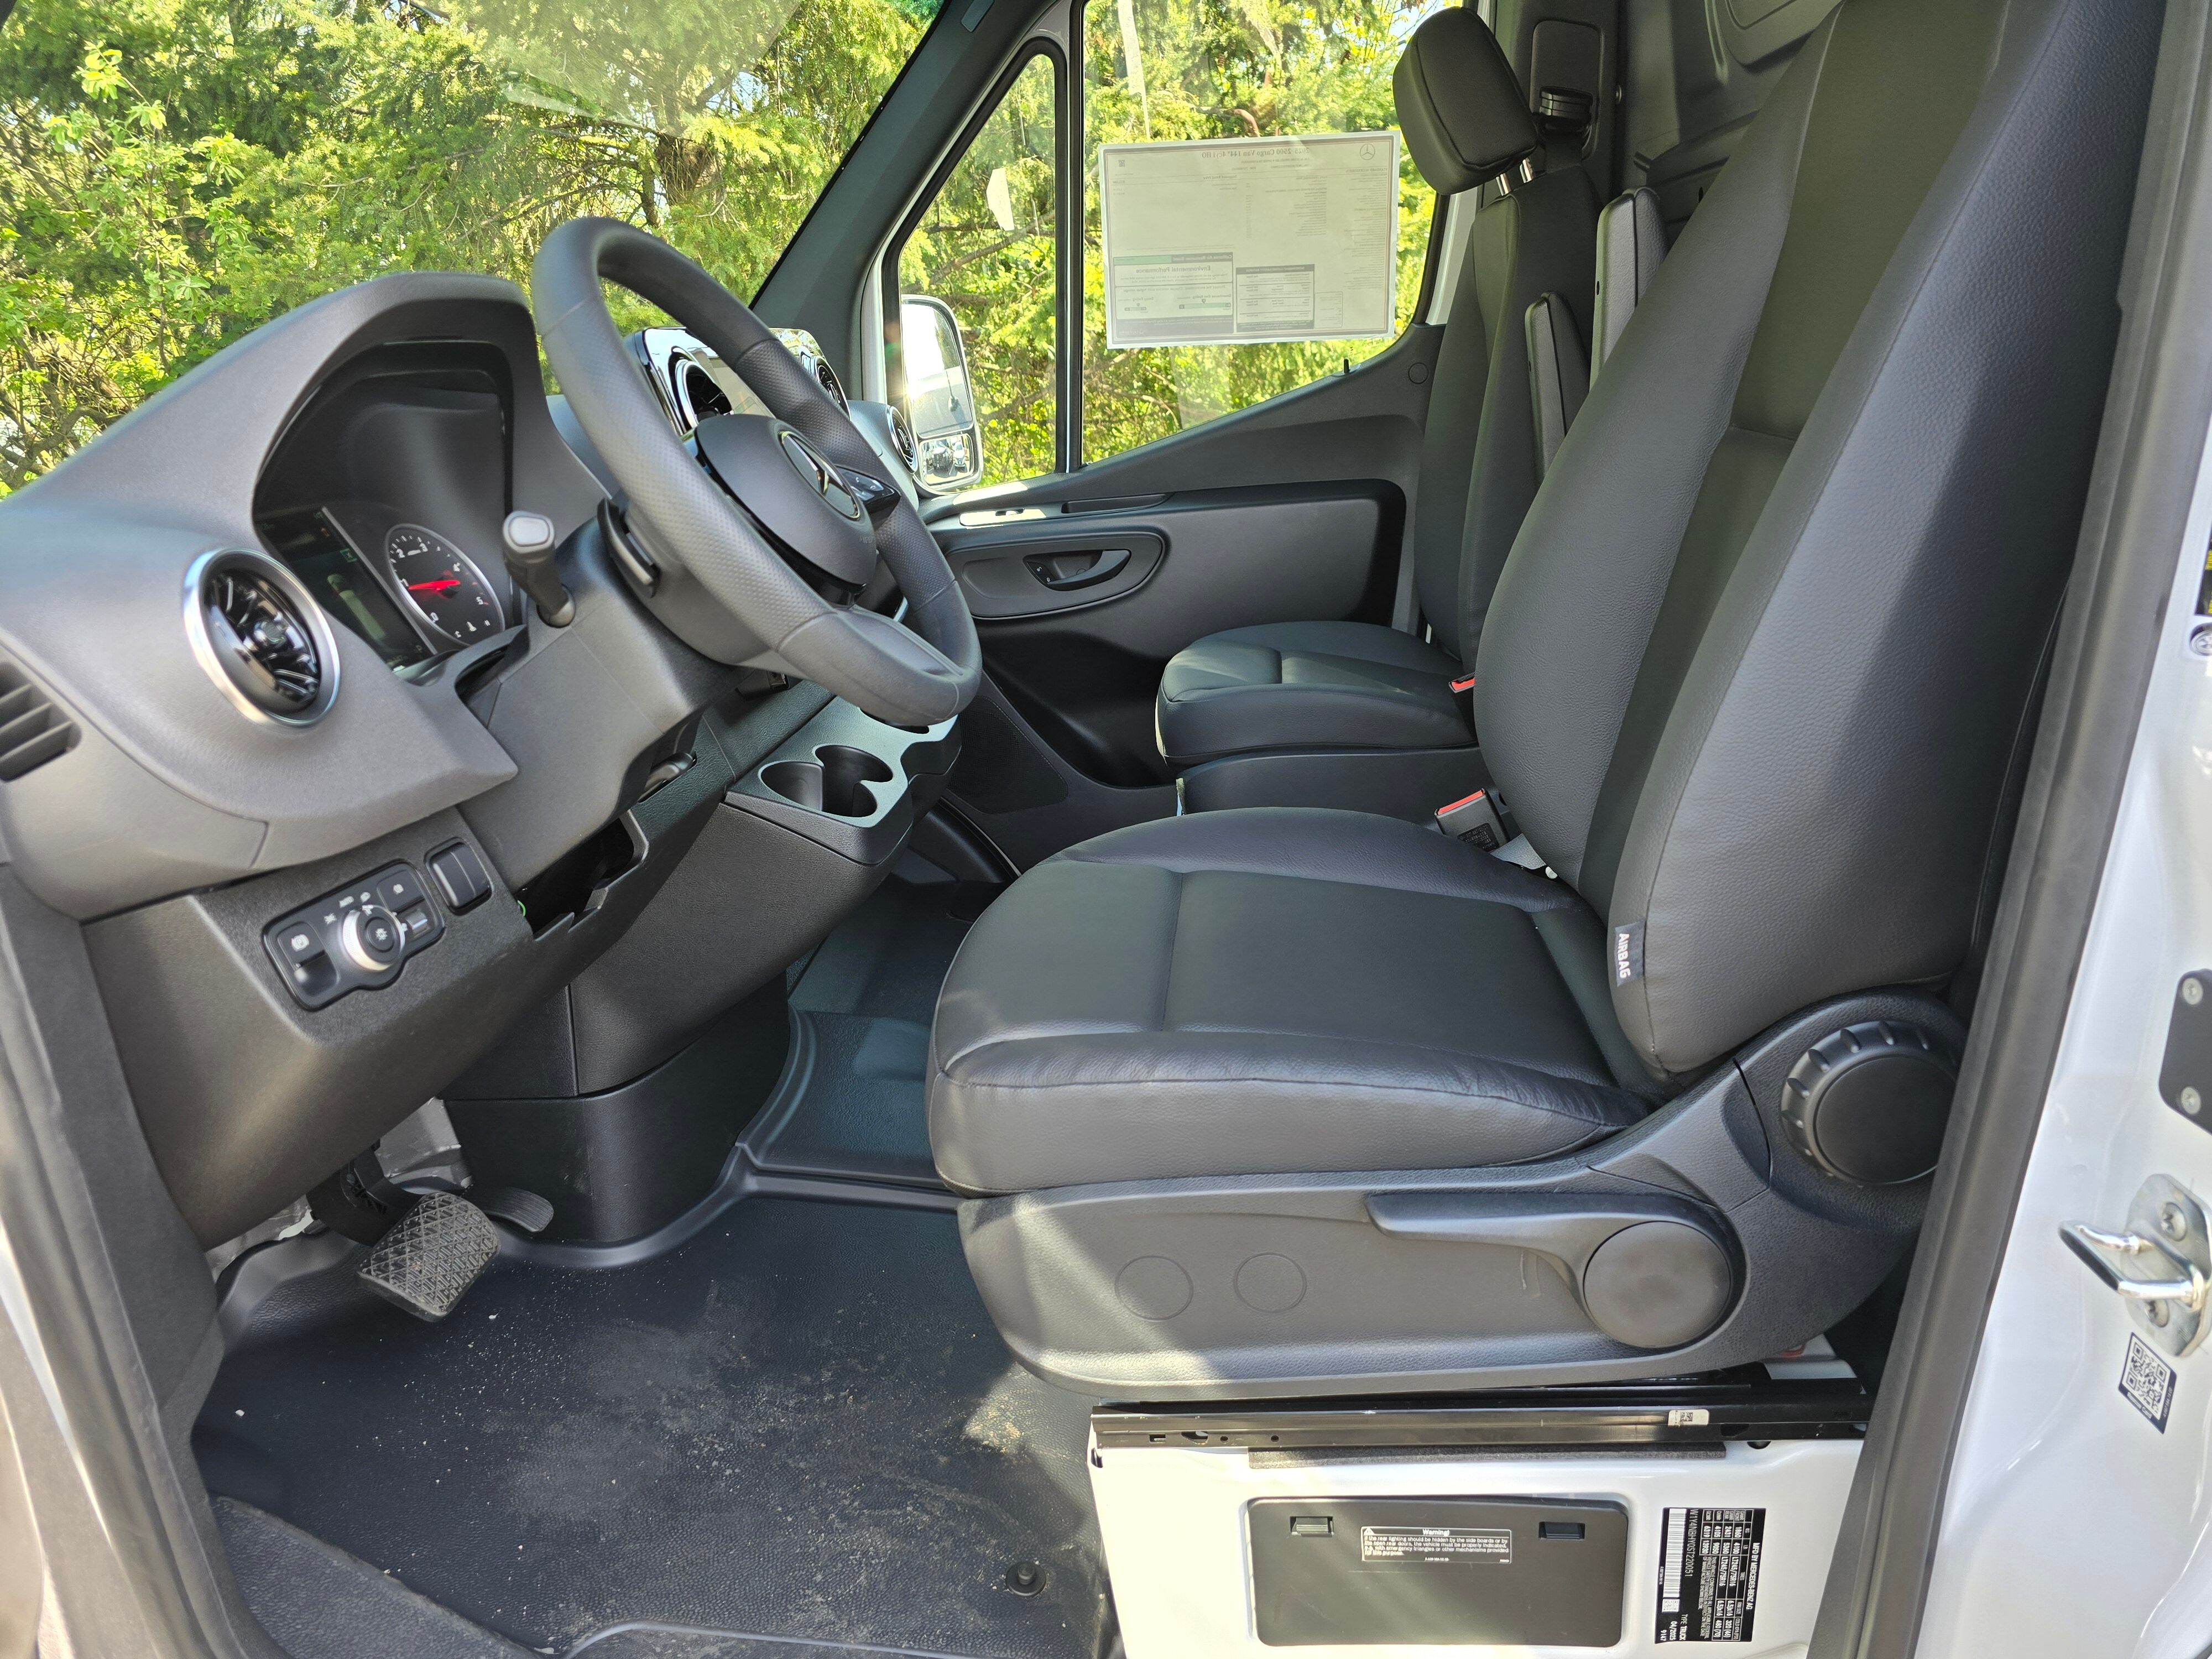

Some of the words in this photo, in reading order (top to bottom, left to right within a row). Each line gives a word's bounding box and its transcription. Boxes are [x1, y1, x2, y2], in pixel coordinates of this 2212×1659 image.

[419, 543, 428, 552] 3
[396, 549, 405, 559] 2
[476, 596, 484, 605] 5
[1617, 933, 1631, 978] AIRBAG
[1722, 1542, 1730, 1554] 5360
[1752, 1542, 1760, 1554] MFD
[1719, 1556, 1729, 1587] LT245/75R16
[1729, 1556, 1739, 1587] LT245/75R16
[1747, 1562, 1758, 1601] MERCEDES-BENZ
[1670, 1621, 1678, 1641] 04/2025
[1723, 1629, 1731, 1637] (46)
